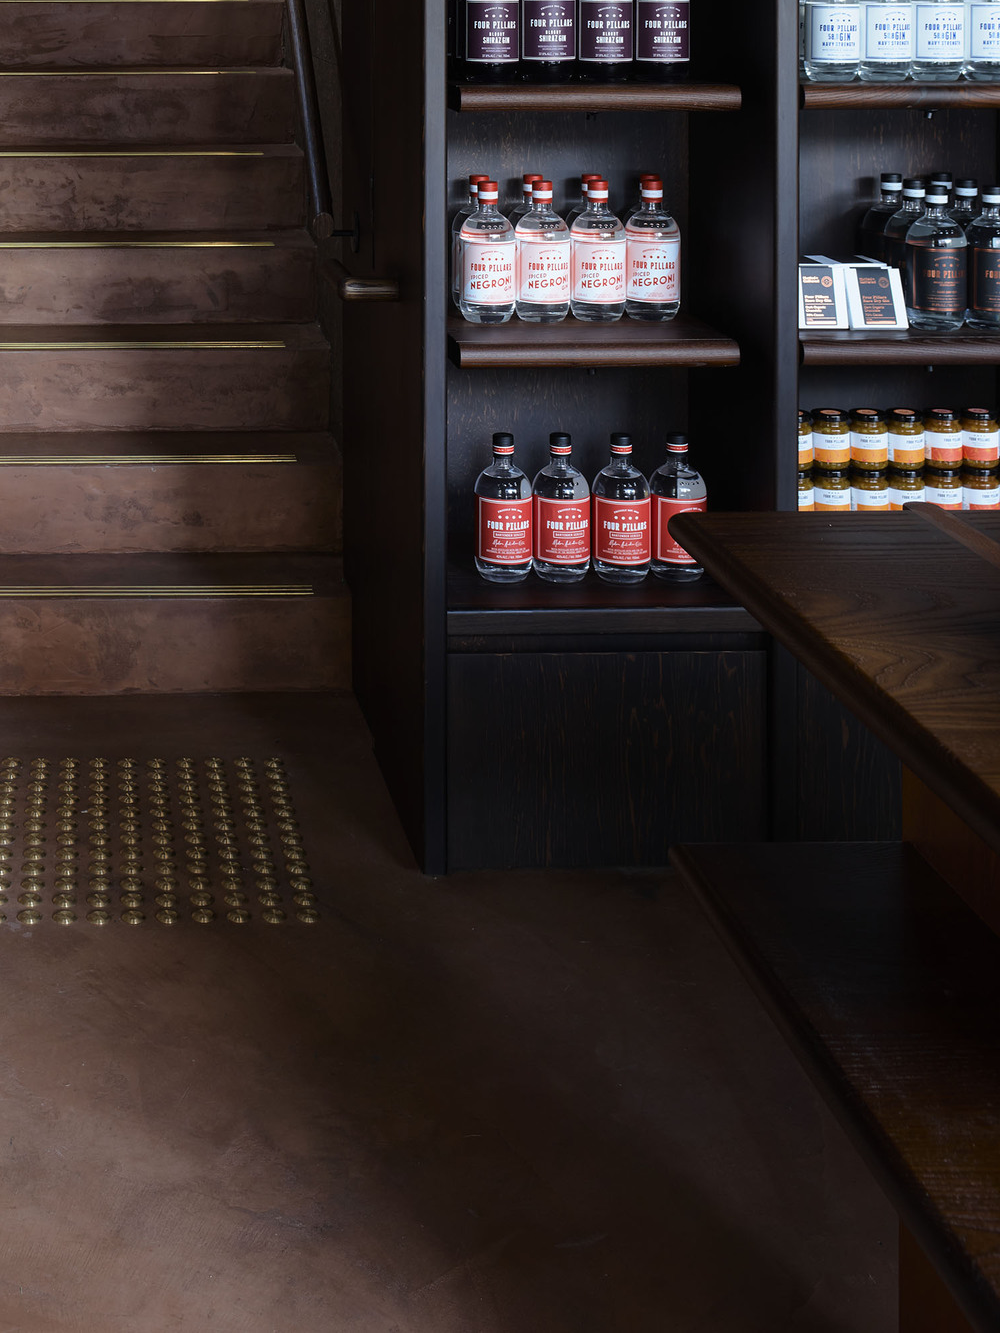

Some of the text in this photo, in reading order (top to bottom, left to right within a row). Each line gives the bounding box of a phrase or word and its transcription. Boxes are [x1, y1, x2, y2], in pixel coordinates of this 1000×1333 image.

[474, 20, 516, 29] FOUR PILLARS
[530, 19, 573, 27] FOUR PILLARS
[587, 20, 630, 29] FOUR PILLARS
[645, 20, 687, 28] FOUR PILLARS
[819, 24, 834, 32] FOUR
[596, 36, 615, 44] SHIRAZ
[653, 36, 673, 44] SHIRAZ
[839, 32, 851, 41] GIN
[895, 32, 905, 40] GIN
[945, 31, 956, 40] GIN
[470, 263, 512, 272] FOUR PILLARS
[528, 262, 568, 271] FOUR PILLARS
[581, 262, 623, 271] FOUR PILLARS
[632, 260, 675, 270] FOUR PILLARS
[470, 275, 512, 290] NEGRONI
[528, 274, 568, 289] NEGRONI
[581, 273, 623, 288] NEGRONI
[632, 273, 675, 287] NEGRONI
[487, 520, 529, 531] FOUR PILLARS
[546, 519, 588, 530] FOUR PILLARS
[603, 520, 647, 531] FOUR PILLARS
